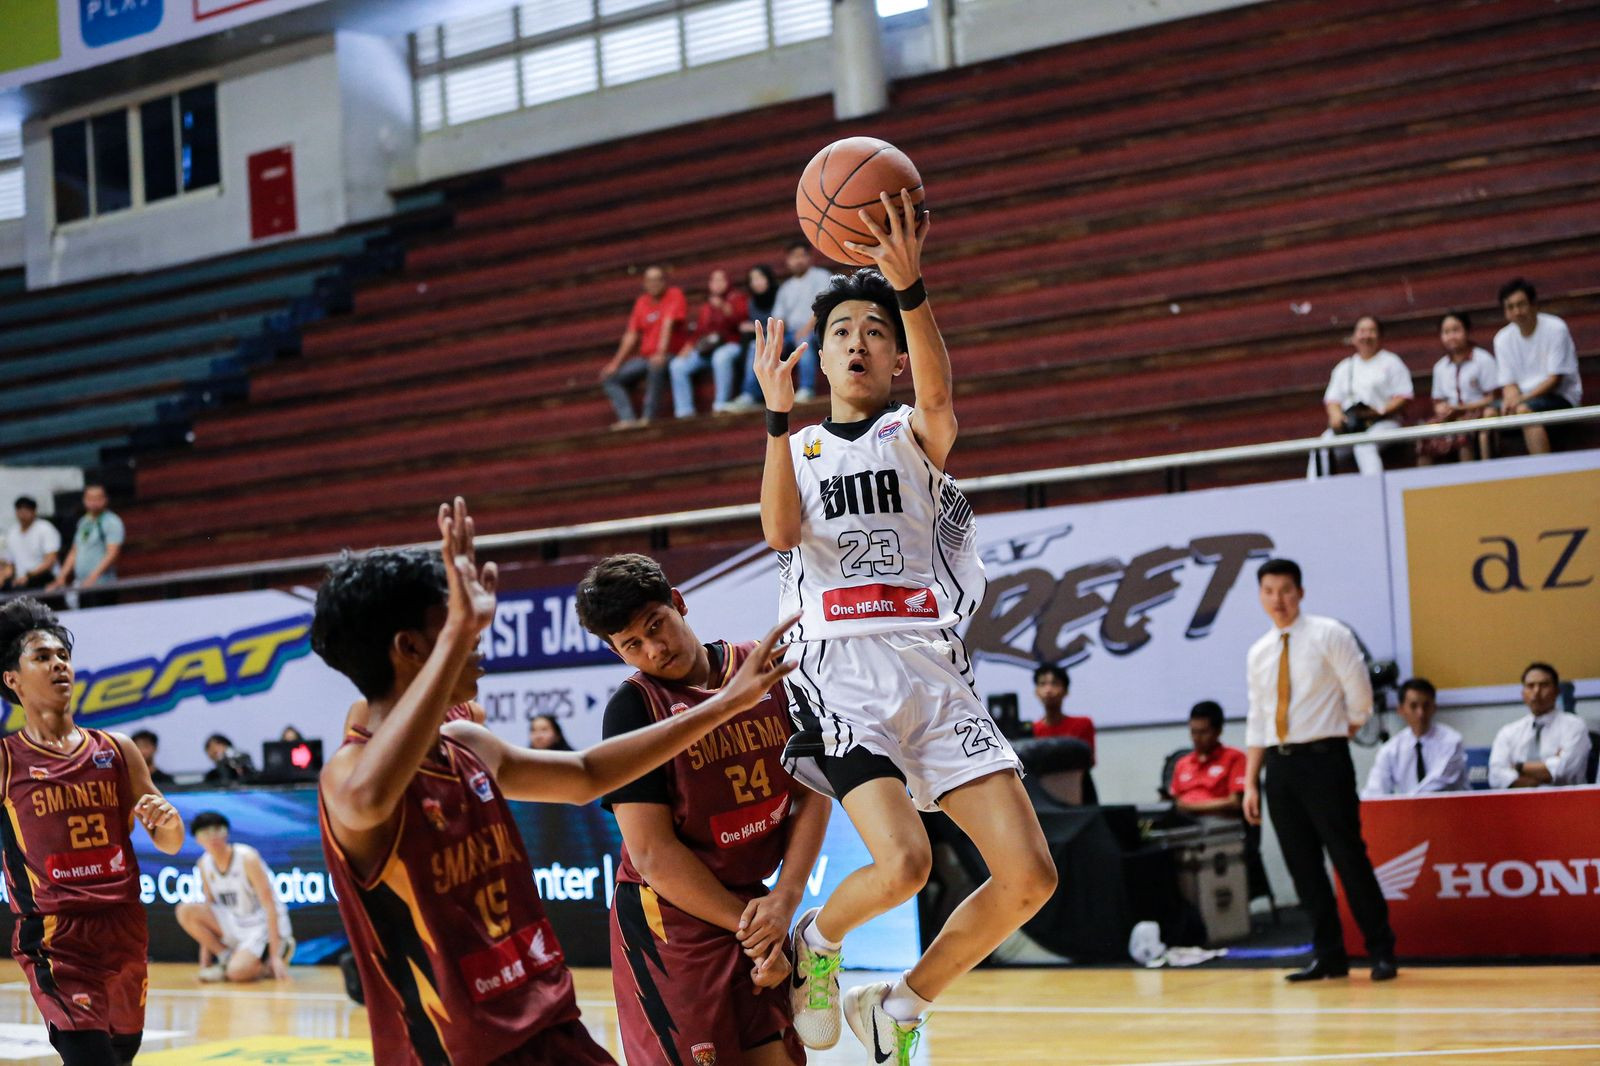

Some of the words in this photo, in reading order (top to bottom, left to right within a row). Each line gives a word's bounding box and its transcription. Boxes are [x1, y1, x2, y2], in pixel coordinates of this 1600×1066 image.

[837, 529, 904, 579] 23
[830, 604, 854, 616] One
[962, 533, 1275, 668] REET
[477, 600, 534, 661] AST
[541, 595, 609, 656] JA
[4, 620, 310, 732] eAT
[687, 716, 786, 771] SMANEMA
[724, 758, 772, 804] 24
[67, 813, 109, 849] 23
[720, 829, 740, 844] One
[52, 867, 71, 879] One
[269, 867, 325, 903] ata
[533, 862, 599, 900] nter
[1433, 858, 1600, 898] HON
[474, 878, 512, 939] 15
[475, 975, 501, 994] One
